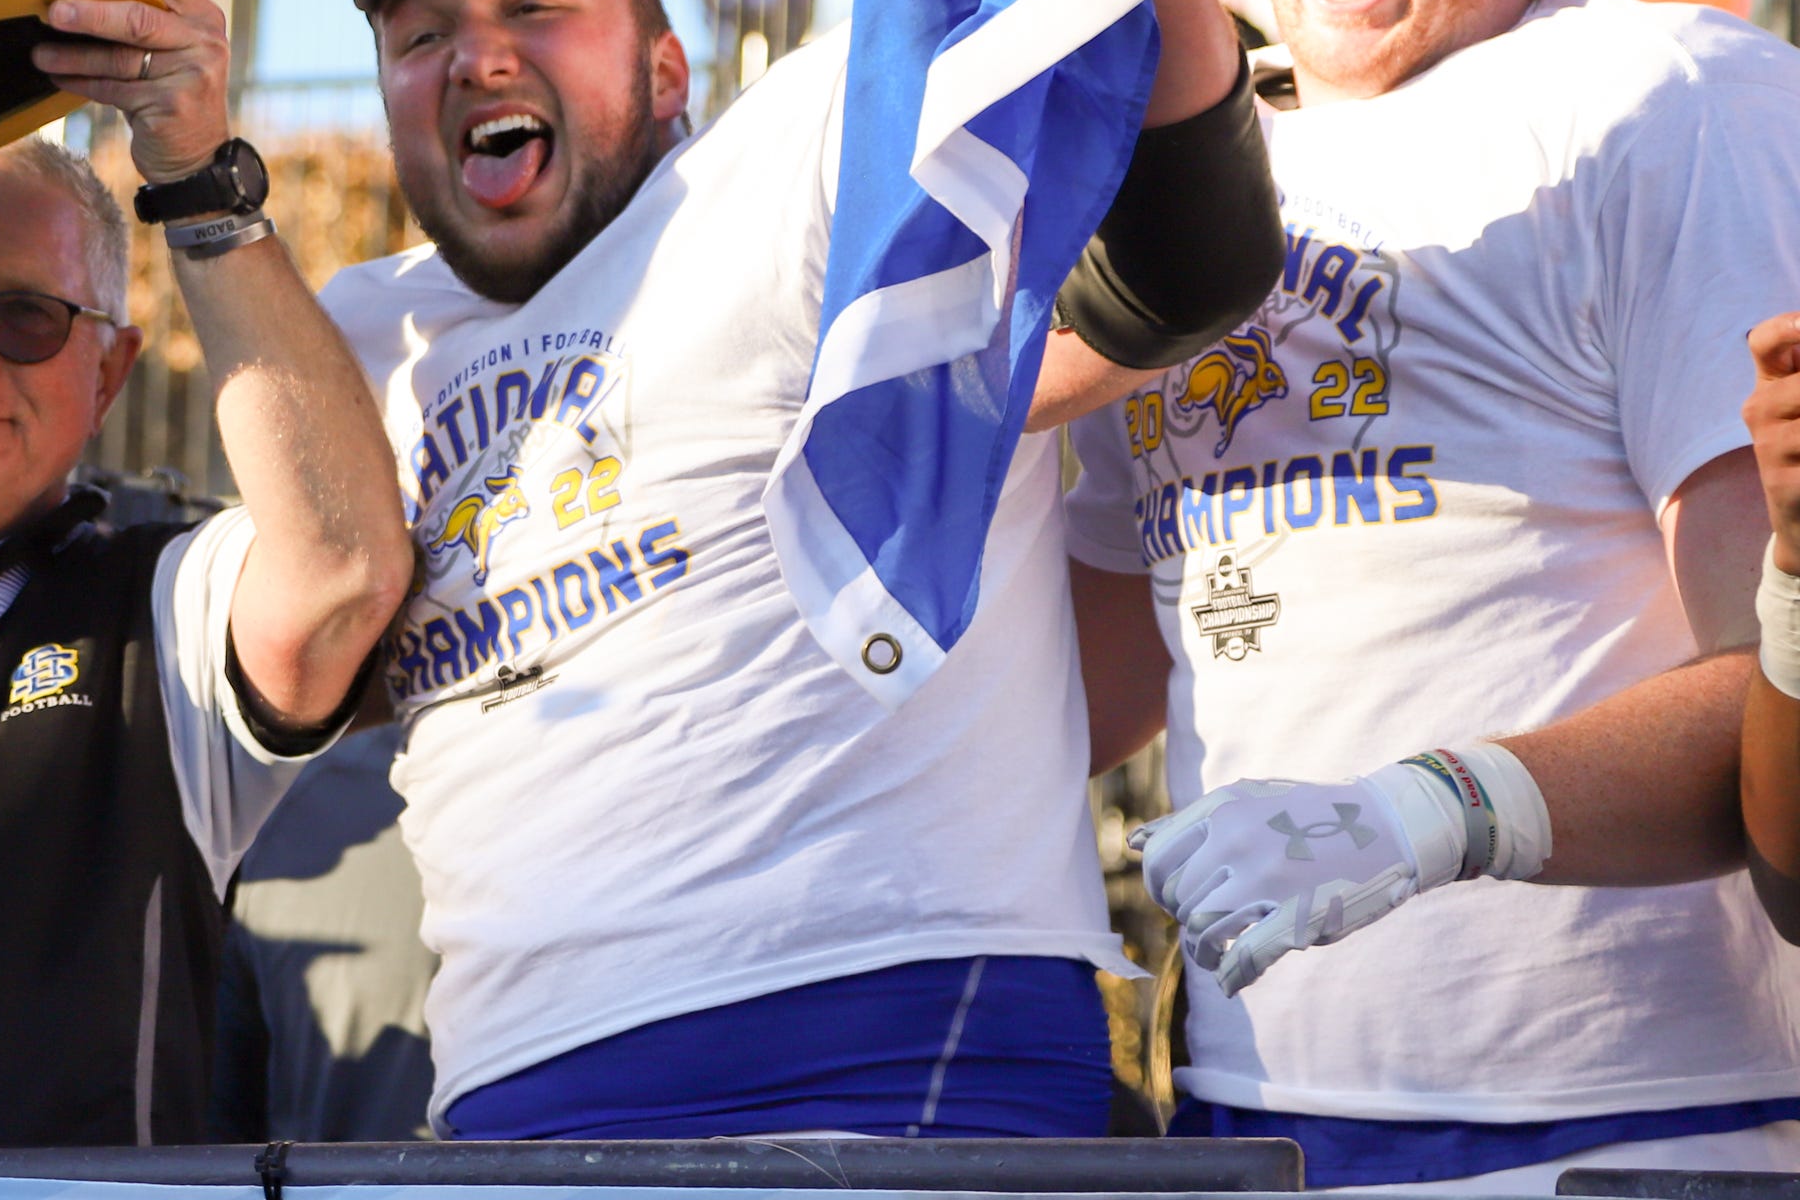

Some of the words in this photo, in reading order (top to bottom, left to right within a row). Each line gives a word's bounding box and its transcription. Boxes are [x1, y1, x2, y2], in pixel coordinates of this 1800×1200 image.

[437, 343, 512, 405] DIVISION
[1125, 390, 1164, 458] 20
[1309, 356, 1390, 421] 22
[404, 354, 622, 529] ATIONAL
[550, 454, 624, 531] 22
[388, 516, 693, 699] HAMPIONS
[1201, 601, 1277, 629] CHAMPIONSHIP
[1, 693, 93, 722] FOOTBALL
[1461, 776, 1481, 808] Lead
